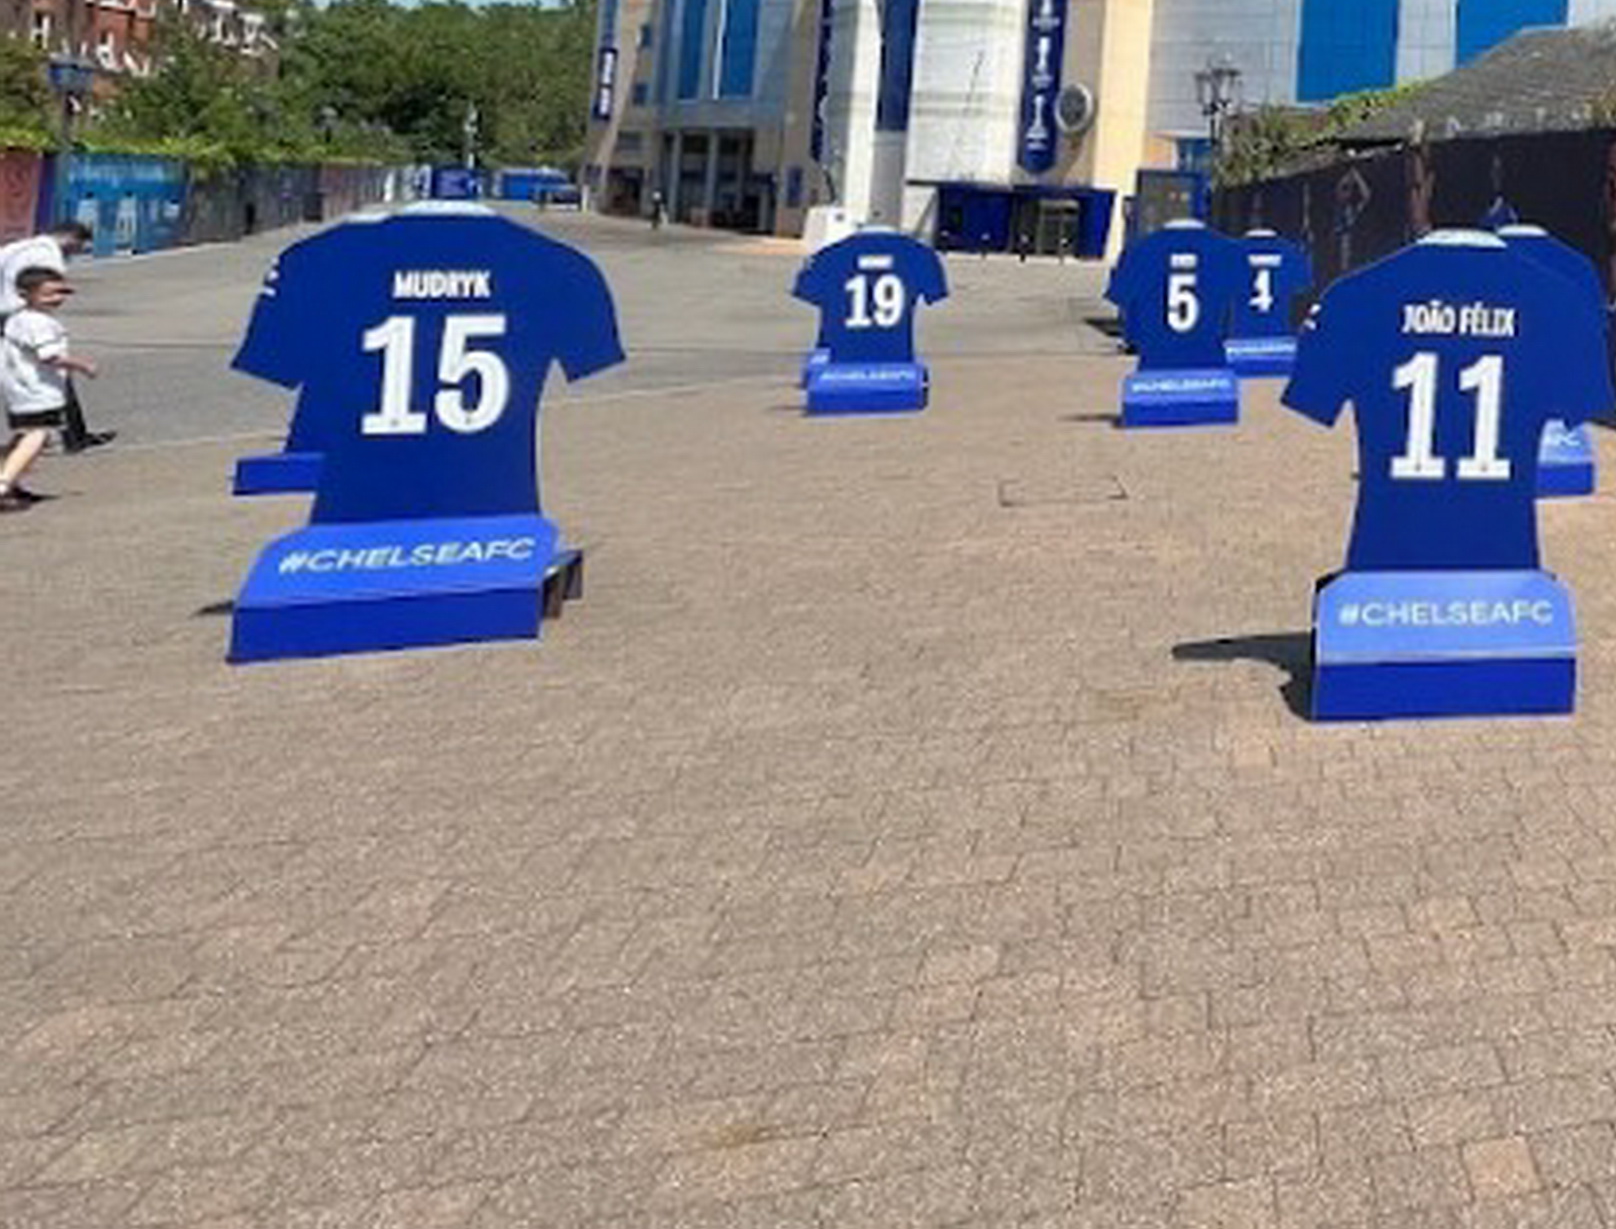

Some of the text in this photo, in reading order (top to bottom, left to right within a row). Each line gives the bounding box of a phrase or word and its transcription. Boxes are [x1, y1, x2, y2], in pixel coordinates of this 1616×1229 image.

[391, 270, 491, 300] MUDRYK
[845, 273, 904, 328] 19
[1167, 273, 1199, 333] 5
[1248, 269, 1274, 313] 4
[1402, 299, 1516, 337] JOÃO FÉLIX
[361, 313, 510, 435] 15
[1389, 351, 1511, 480] 11
[278, 536, 536, 574] #CHELSEAFC
[1338, 599, 1555, 627] #CHELSEAFC
